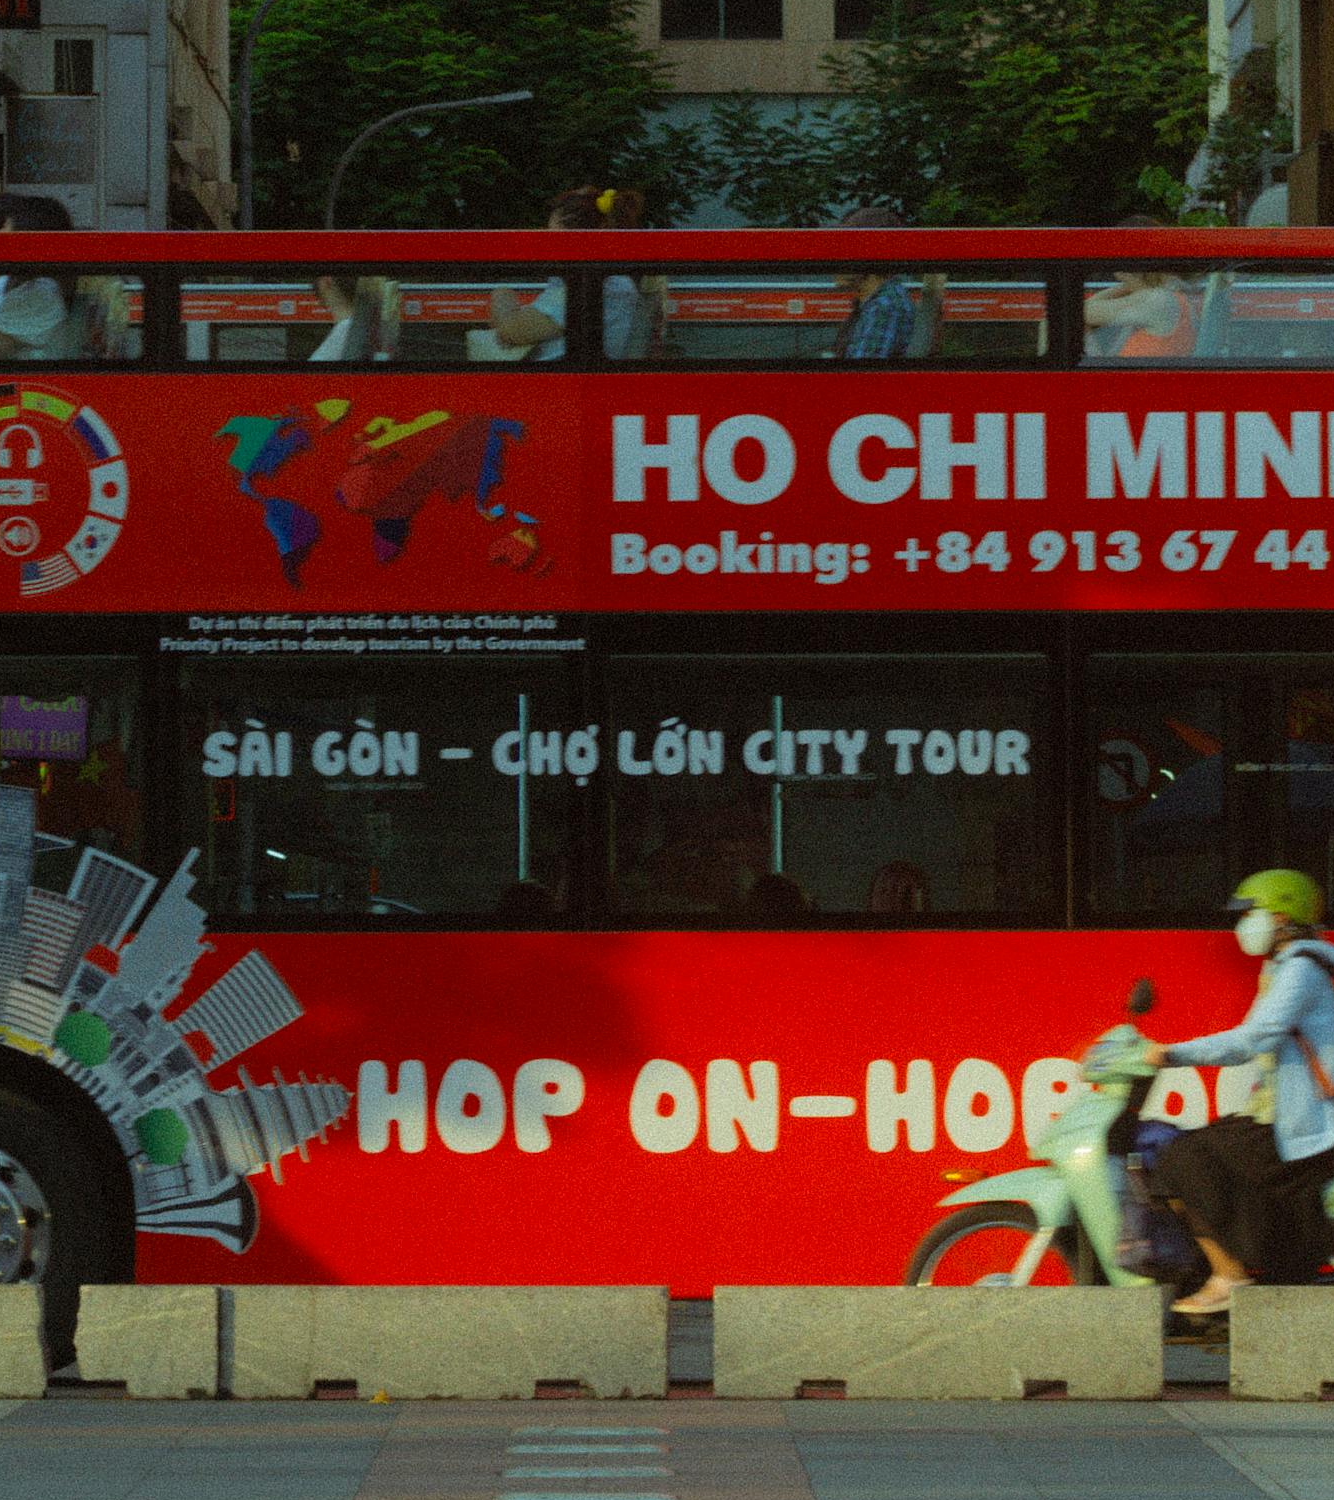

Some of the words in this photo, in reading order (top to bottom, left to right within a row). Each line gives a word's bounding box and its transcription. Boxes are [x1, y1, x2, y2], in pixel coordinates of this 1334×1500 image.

[611, 414, 797, 506] HO
[827, 412, 1048, 505] CHI
[611, 530, 872, 584] Booking:
[894, 529, 1011, 574] +84
[1030, 529, 1142, 573] 913
[1159, 528, 1237, 572] 67
[1254, 528, 1331, 572] 44
[160, 637, 219, 654] Priority
[222, 637, 279, 654] Project
[281, 640, 300, 651] to
[302, 637, 366, 654] develop
[368, 637, 430, 651] tourism
[432, 637, 452, 654] by
[455, 637, 482, 651] the
[485, 637, 586, 651] Government
[201, 718, 292, 779] SÀI
[311, 718, 420, 778] GÒN
[491, 724, 600, 788] CHỢ
[617, 715, 725, 777] LỚN
[743, 729, 867, 777] CITY
[885, 729, 1031, 777] TOUR
[357, 1057, 587, 1154] HOP
